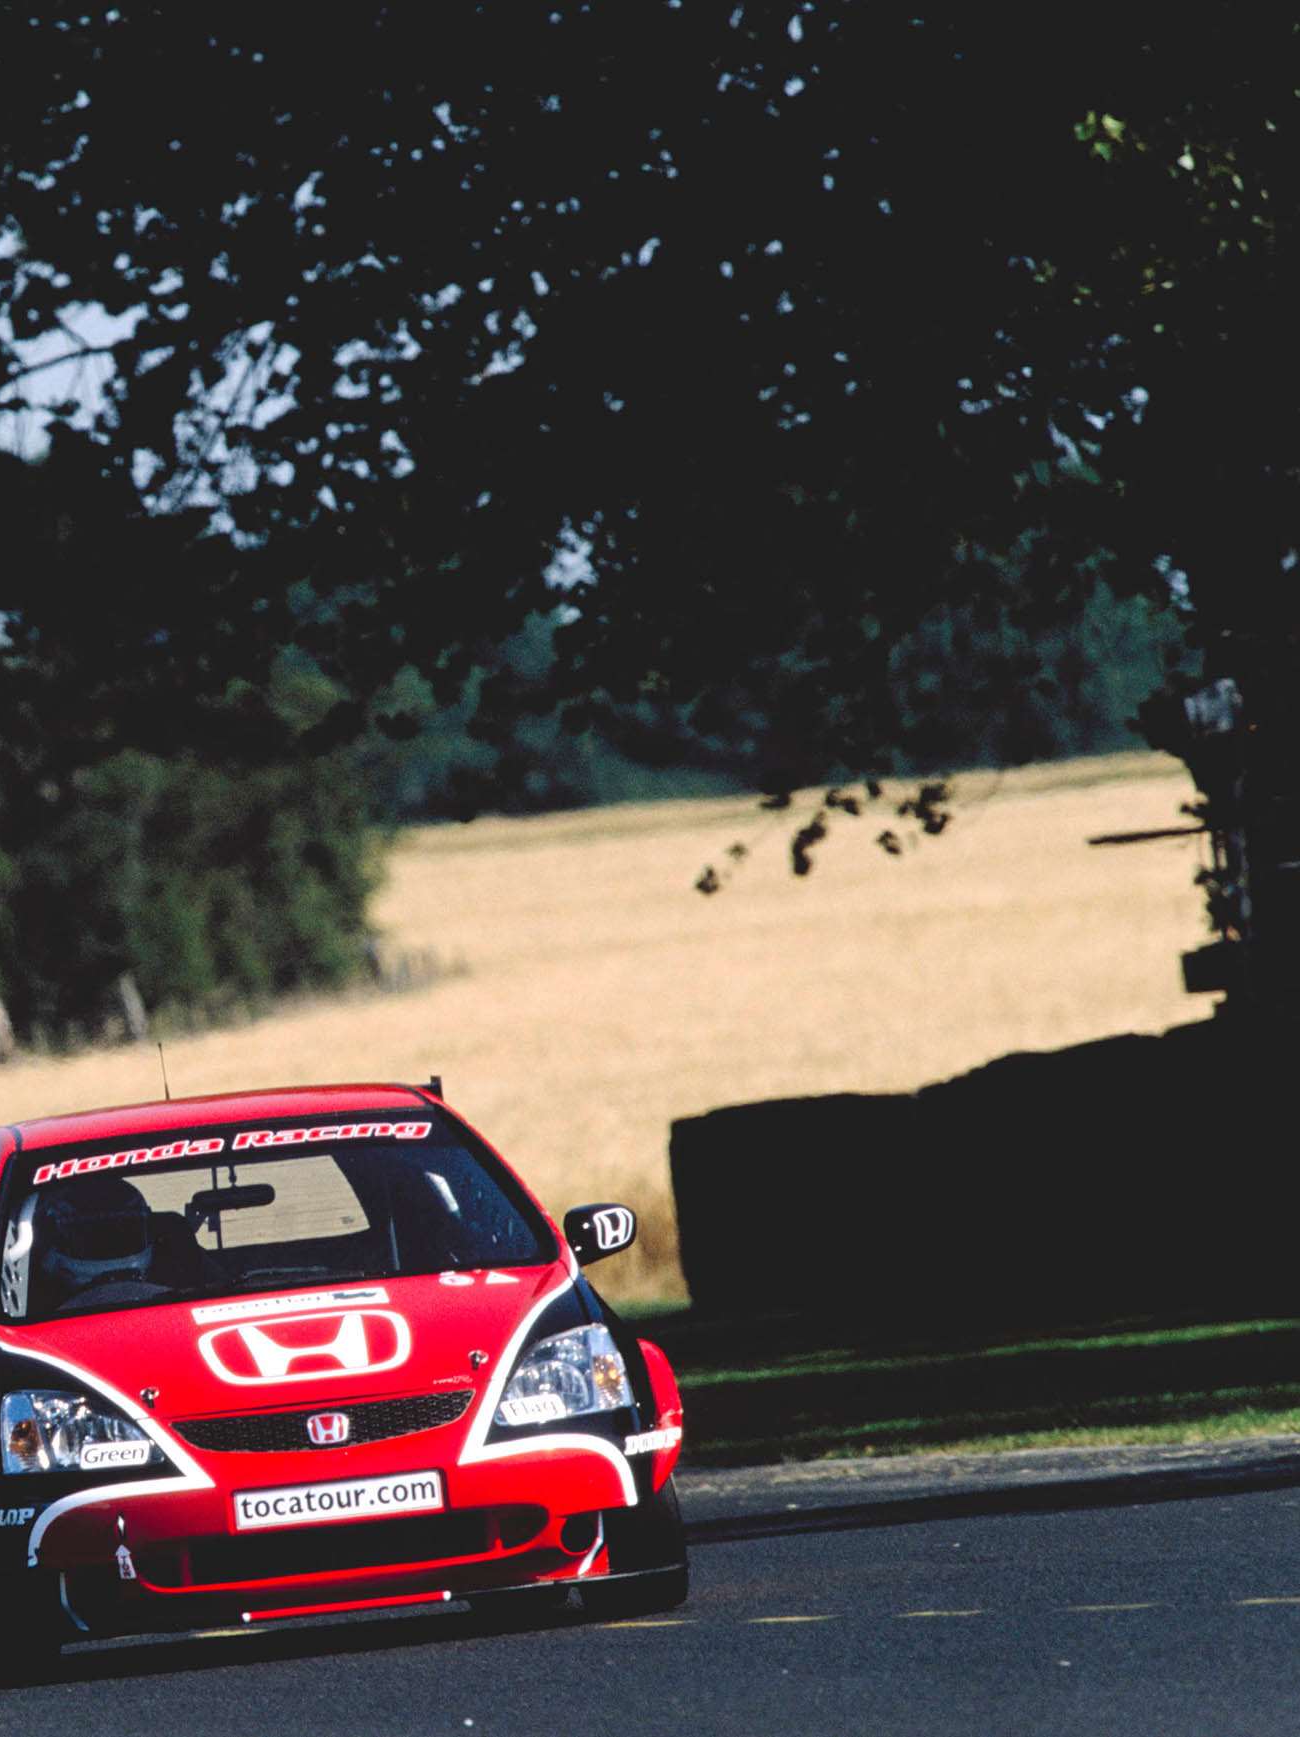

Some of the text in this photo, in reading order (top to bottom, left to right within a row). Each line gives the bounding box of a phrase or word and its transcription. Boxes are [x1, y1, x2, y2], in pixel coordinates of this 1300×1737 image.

[33, 1122, 432, 1185] Honda Racing
[83, 1446, 146, 1465] Green
[241, 1480, 436, 1519] tocatour.com
